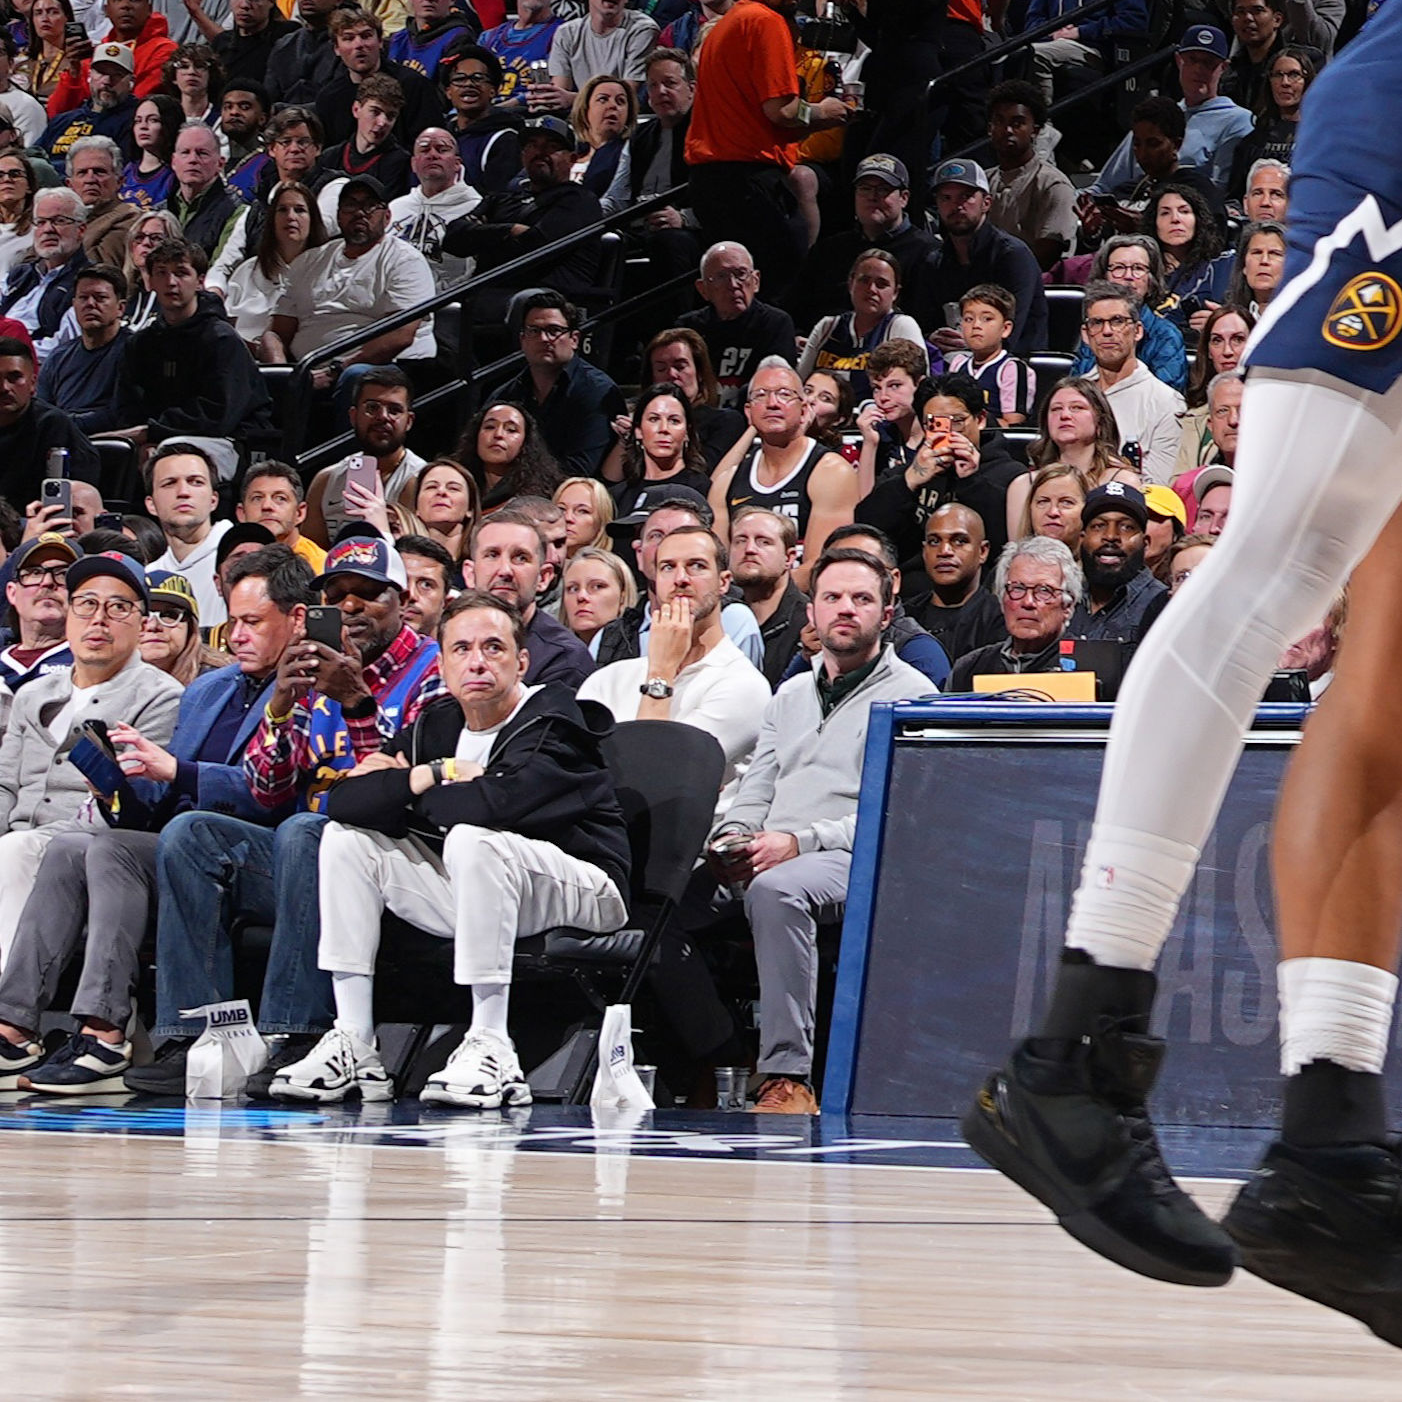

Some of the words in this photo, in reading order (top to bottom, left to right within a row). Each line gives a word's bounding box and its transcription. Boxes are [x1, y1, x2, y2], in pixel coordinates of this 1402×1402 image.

[582, 337, 592, 355] 6
[719, 345, 754, 378] 27
[210, 1008, 249, 1027] UMB
